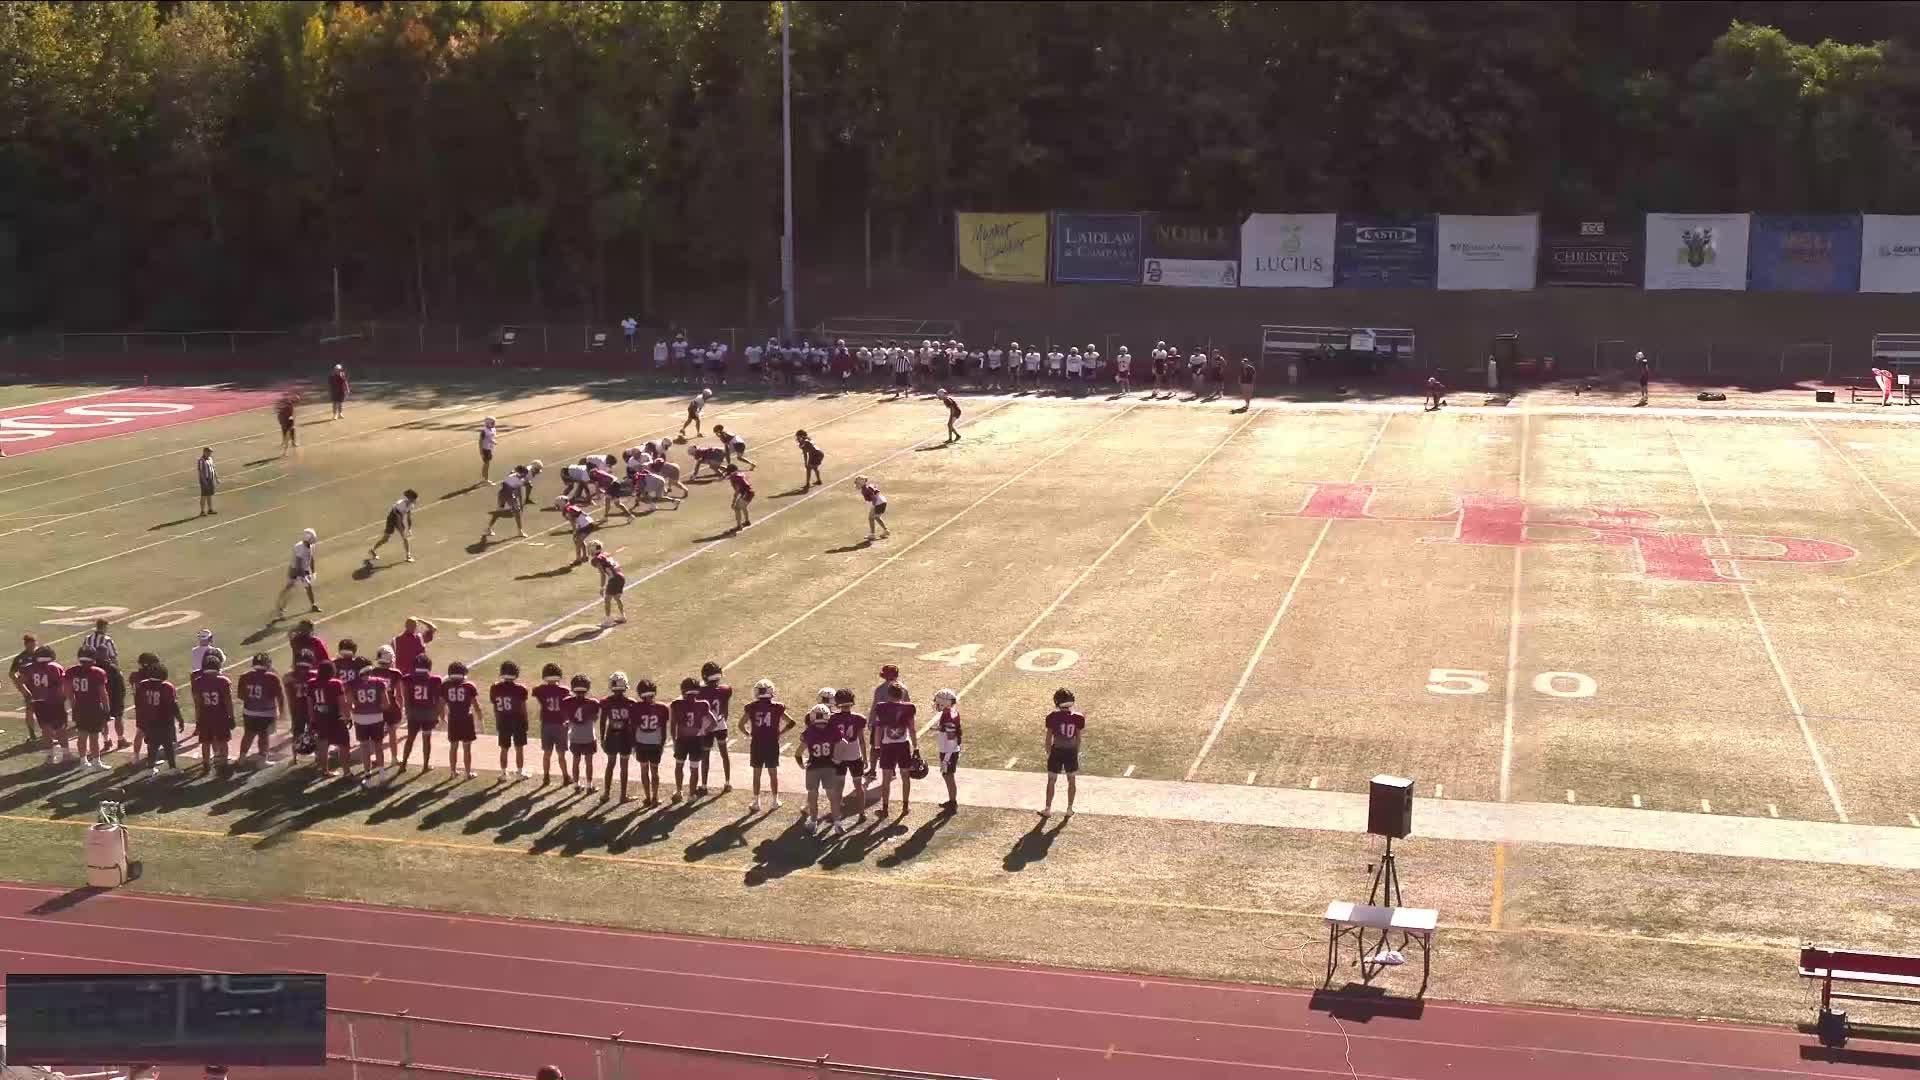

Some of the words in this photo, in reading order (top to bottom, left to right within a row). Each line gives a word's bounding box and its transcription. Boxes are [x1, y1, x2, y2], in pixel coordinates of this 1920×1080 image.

[1064, 227, 1135, 244] LAIDLAW
[1553, 249, 1630, 262] CHRISTIE'S
[1255, 256, 1324, 273] LUCIUS
[33, 673, 49, 688] 84
[574, 707, 583, 722] 4
[641, 714, 659, 730] 32
